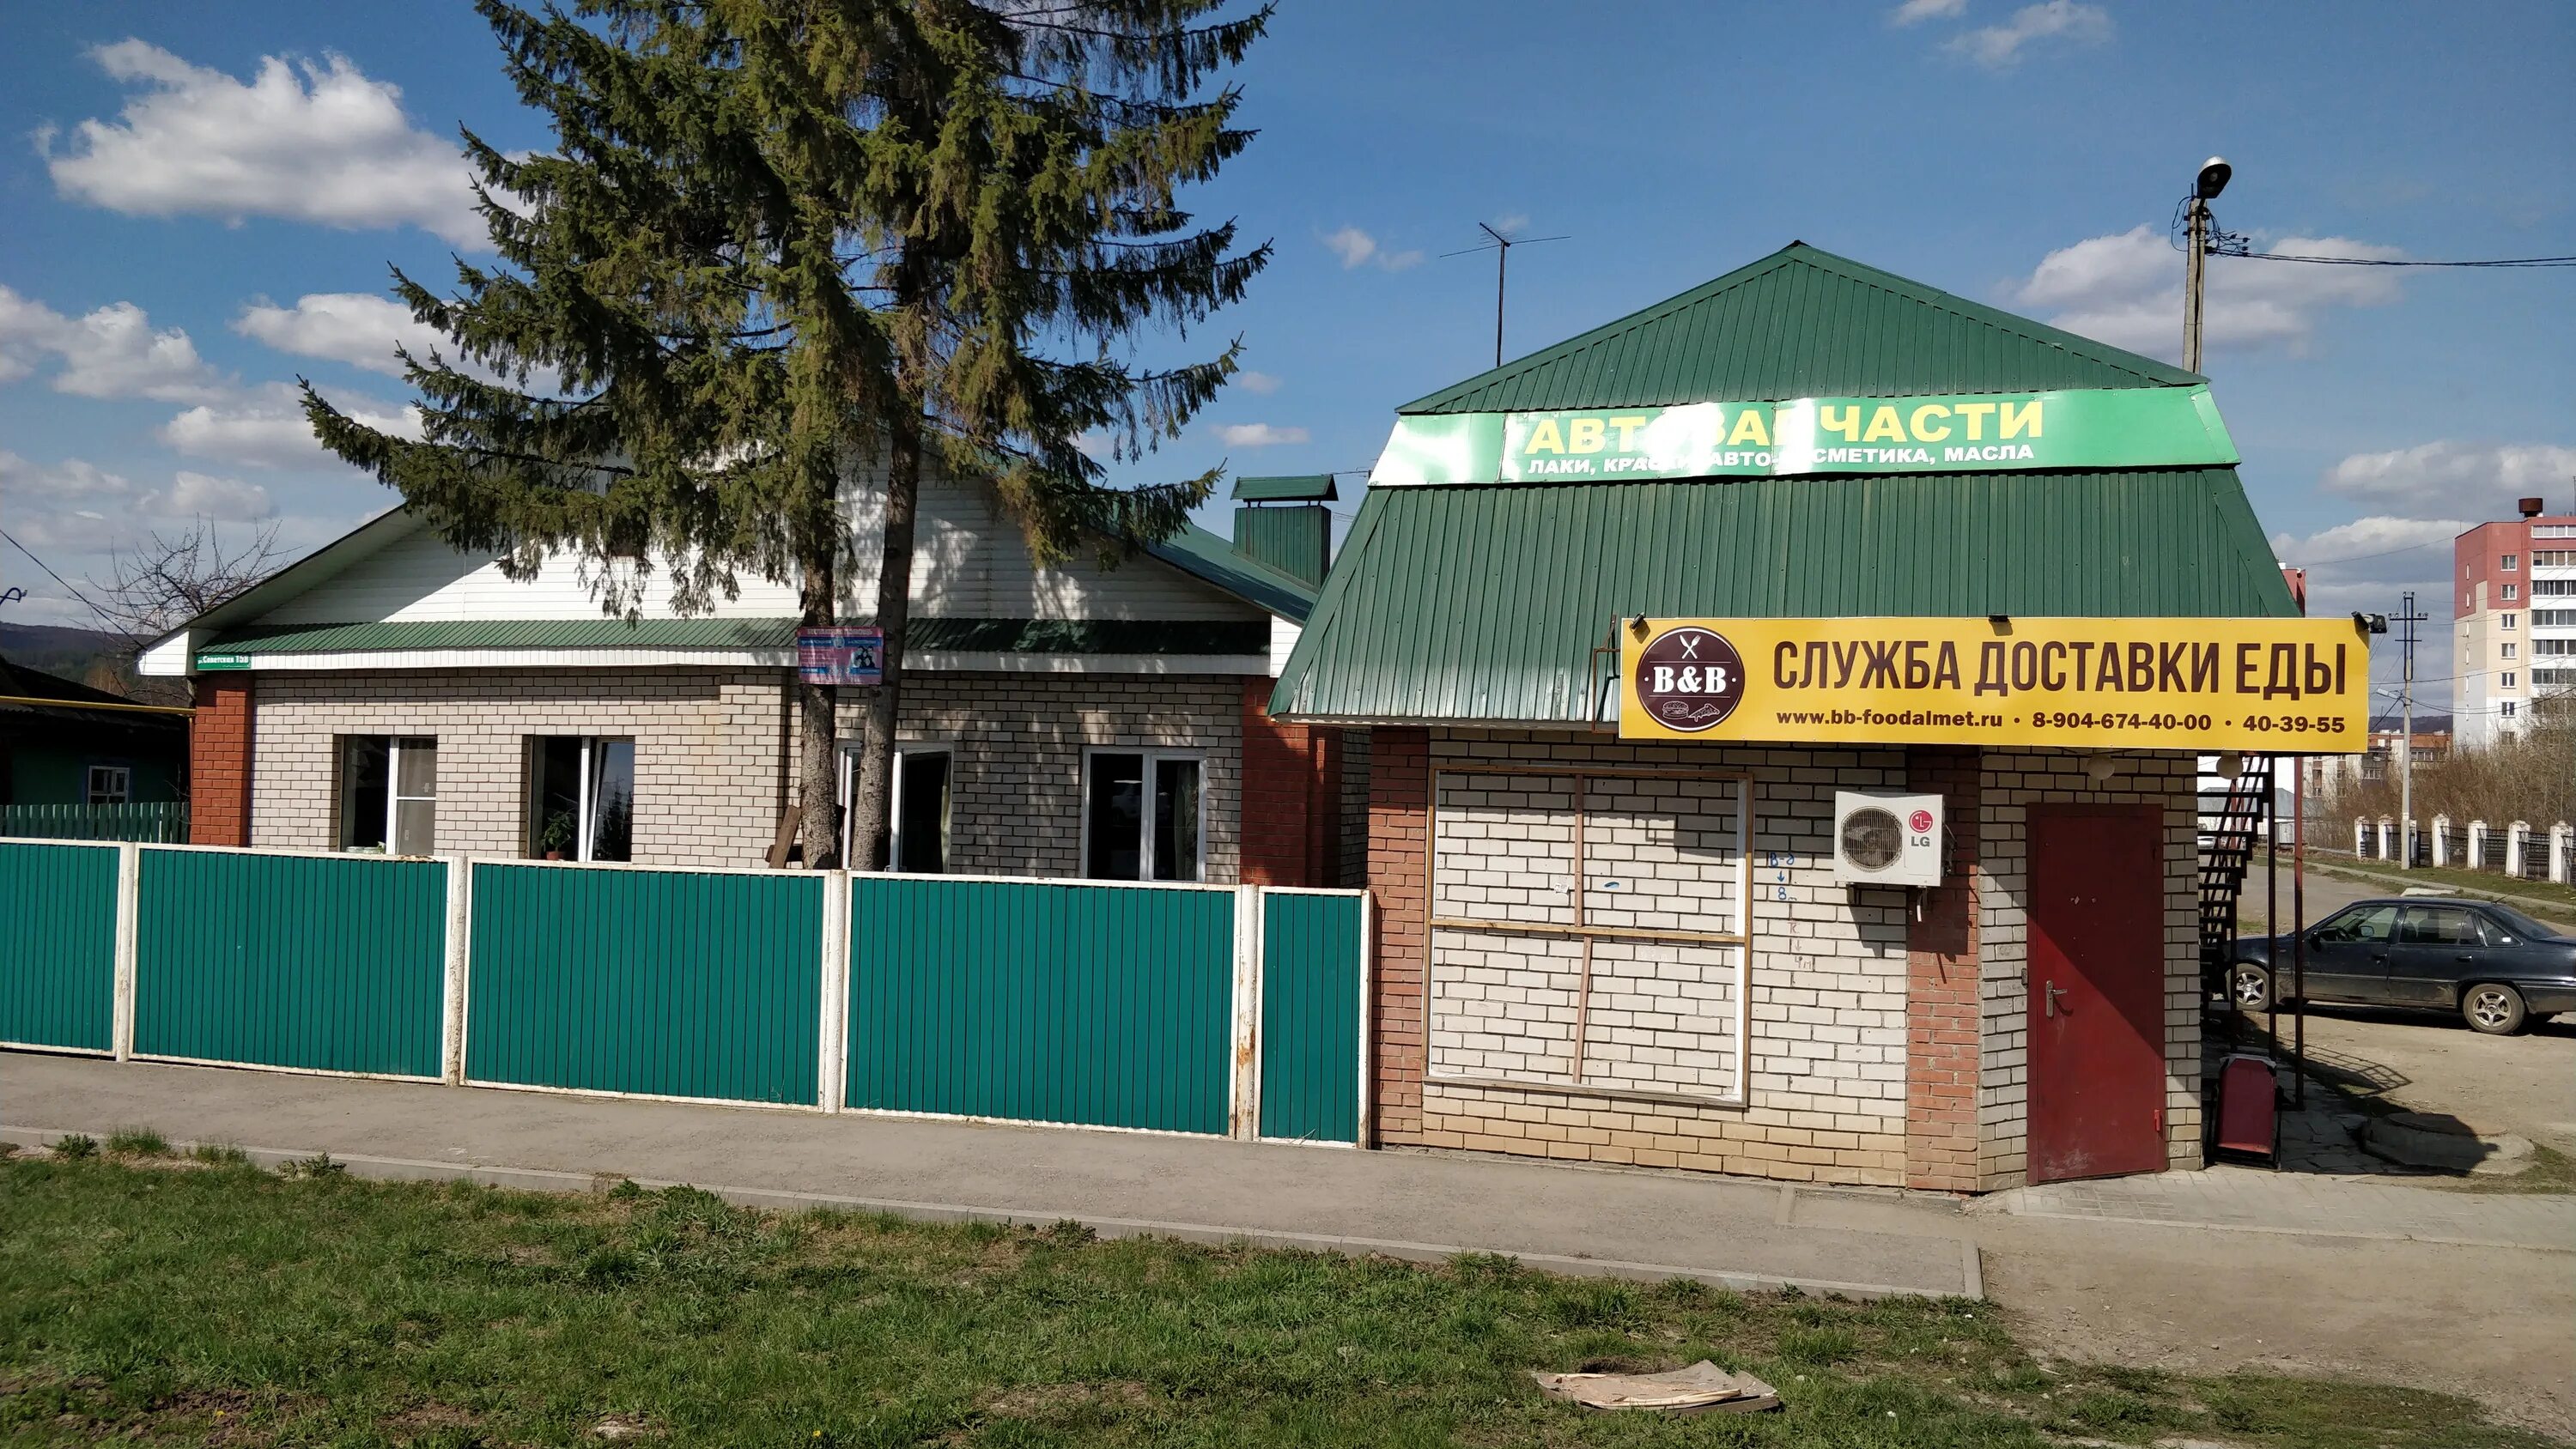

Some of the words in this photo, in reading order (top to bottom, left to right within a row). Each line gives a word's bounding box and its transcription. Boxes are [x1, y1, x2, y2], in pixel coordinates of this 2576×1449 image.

[1528, 458, 1596, 476] ЛАКИ,
[1943, 444, 2035, 463] МАСЛА
[1652, 665, 1728, 694] B&B
[1773, 640, 1961, 690] СЛУЖБА
[1974, 640, 2220, 697] ДОСТАВКИ
[2235, 642, 2347, 700] ЕДЫ
[1776, 709, 2003, 727] www.bb-foodalmet.ru
[2032, 712, 2212, 731] 8-904-674-40-00
[2242, 715, 2346, 733] 40-39-55
[1911, 836, 1930, 847] LG
